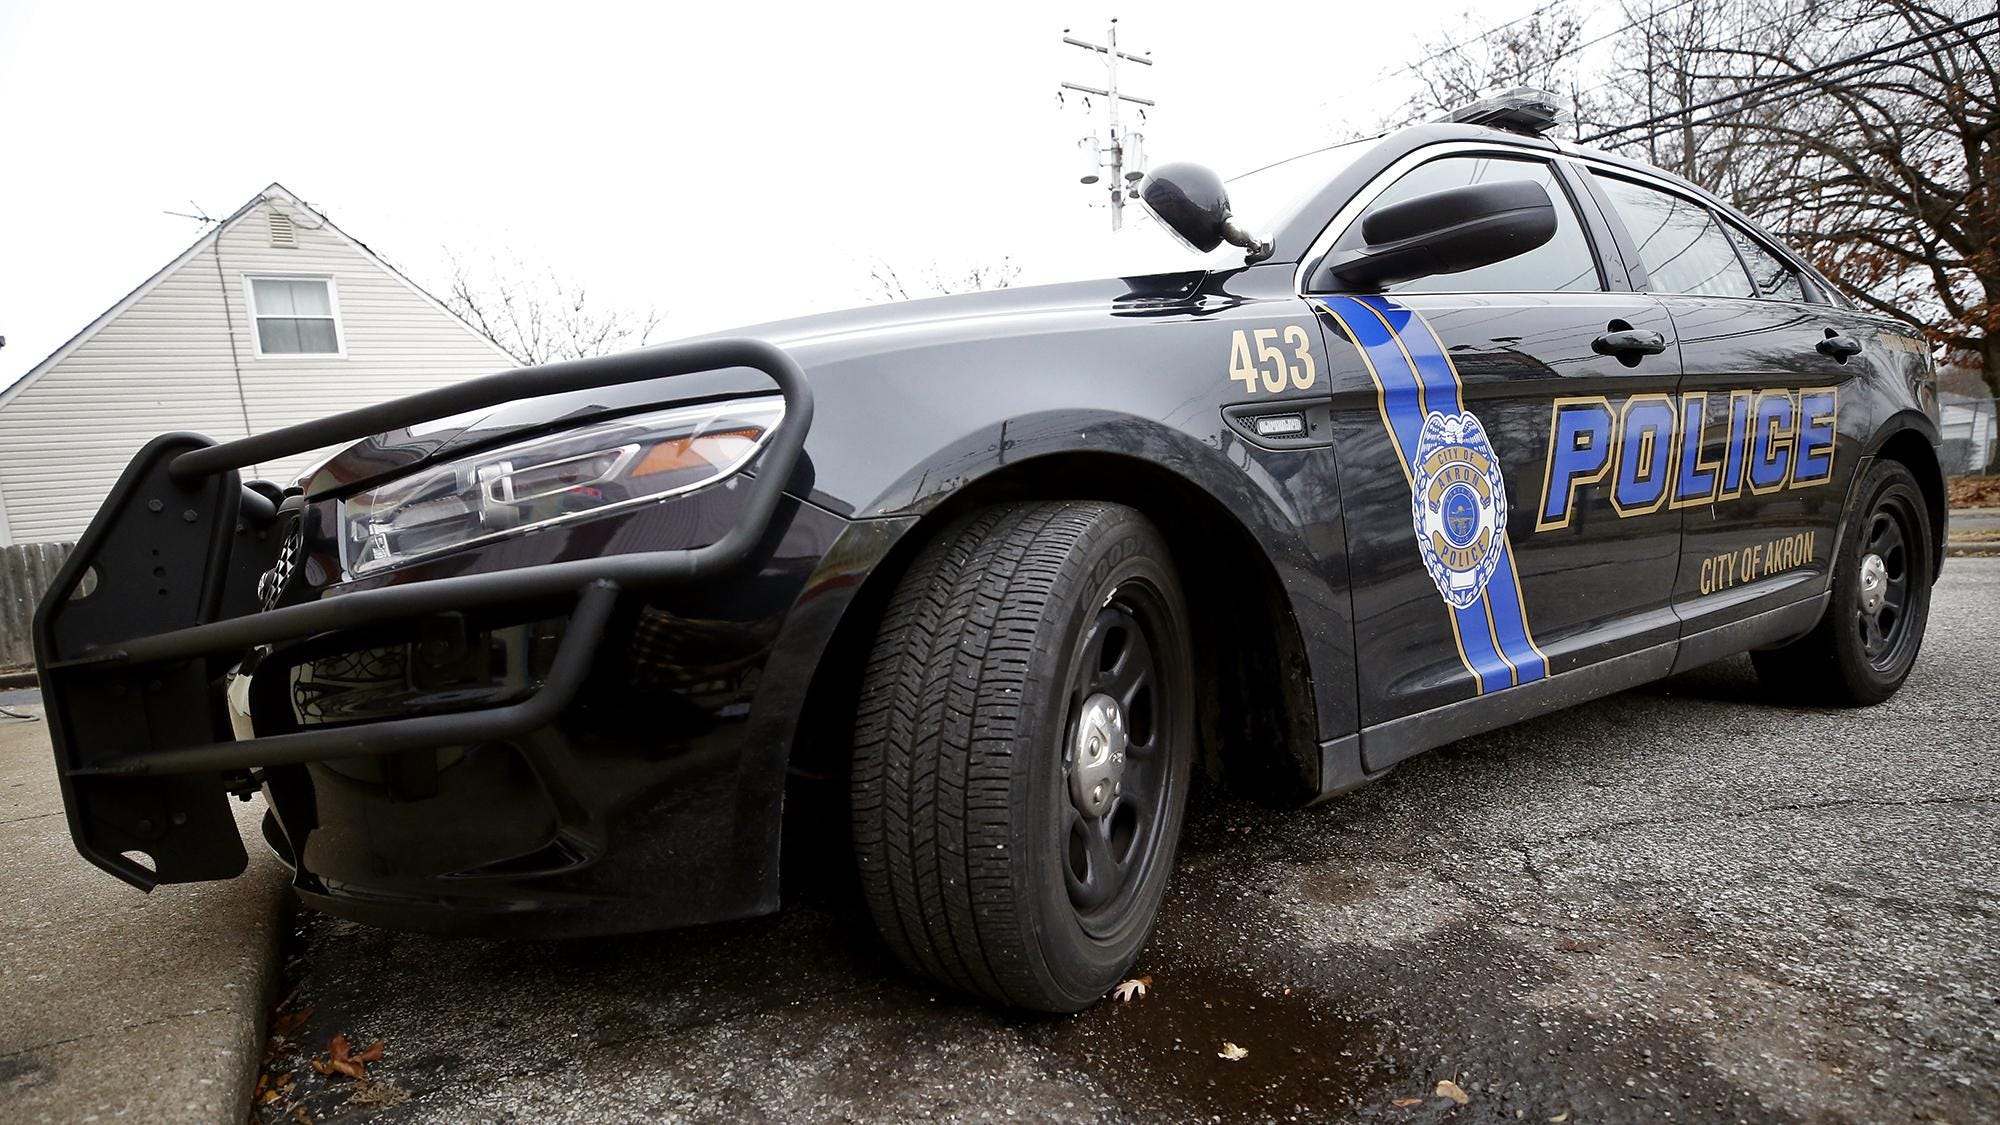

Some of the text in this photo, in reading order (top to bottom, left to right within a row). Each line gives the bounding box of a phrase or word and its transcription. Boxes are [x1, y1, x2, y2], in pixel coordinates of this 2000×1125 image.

[1229, 325, 1315, 393] 453
[1438, 448, 1474, 464] CITY OF
[1438, 467, 1480, 490] AKRON
[1535, 386, 1838, 533] POLICE
[1441, 540, 1486, 567] POLICE
[1700, 531, 1814, 595] CITY OF AKRON
